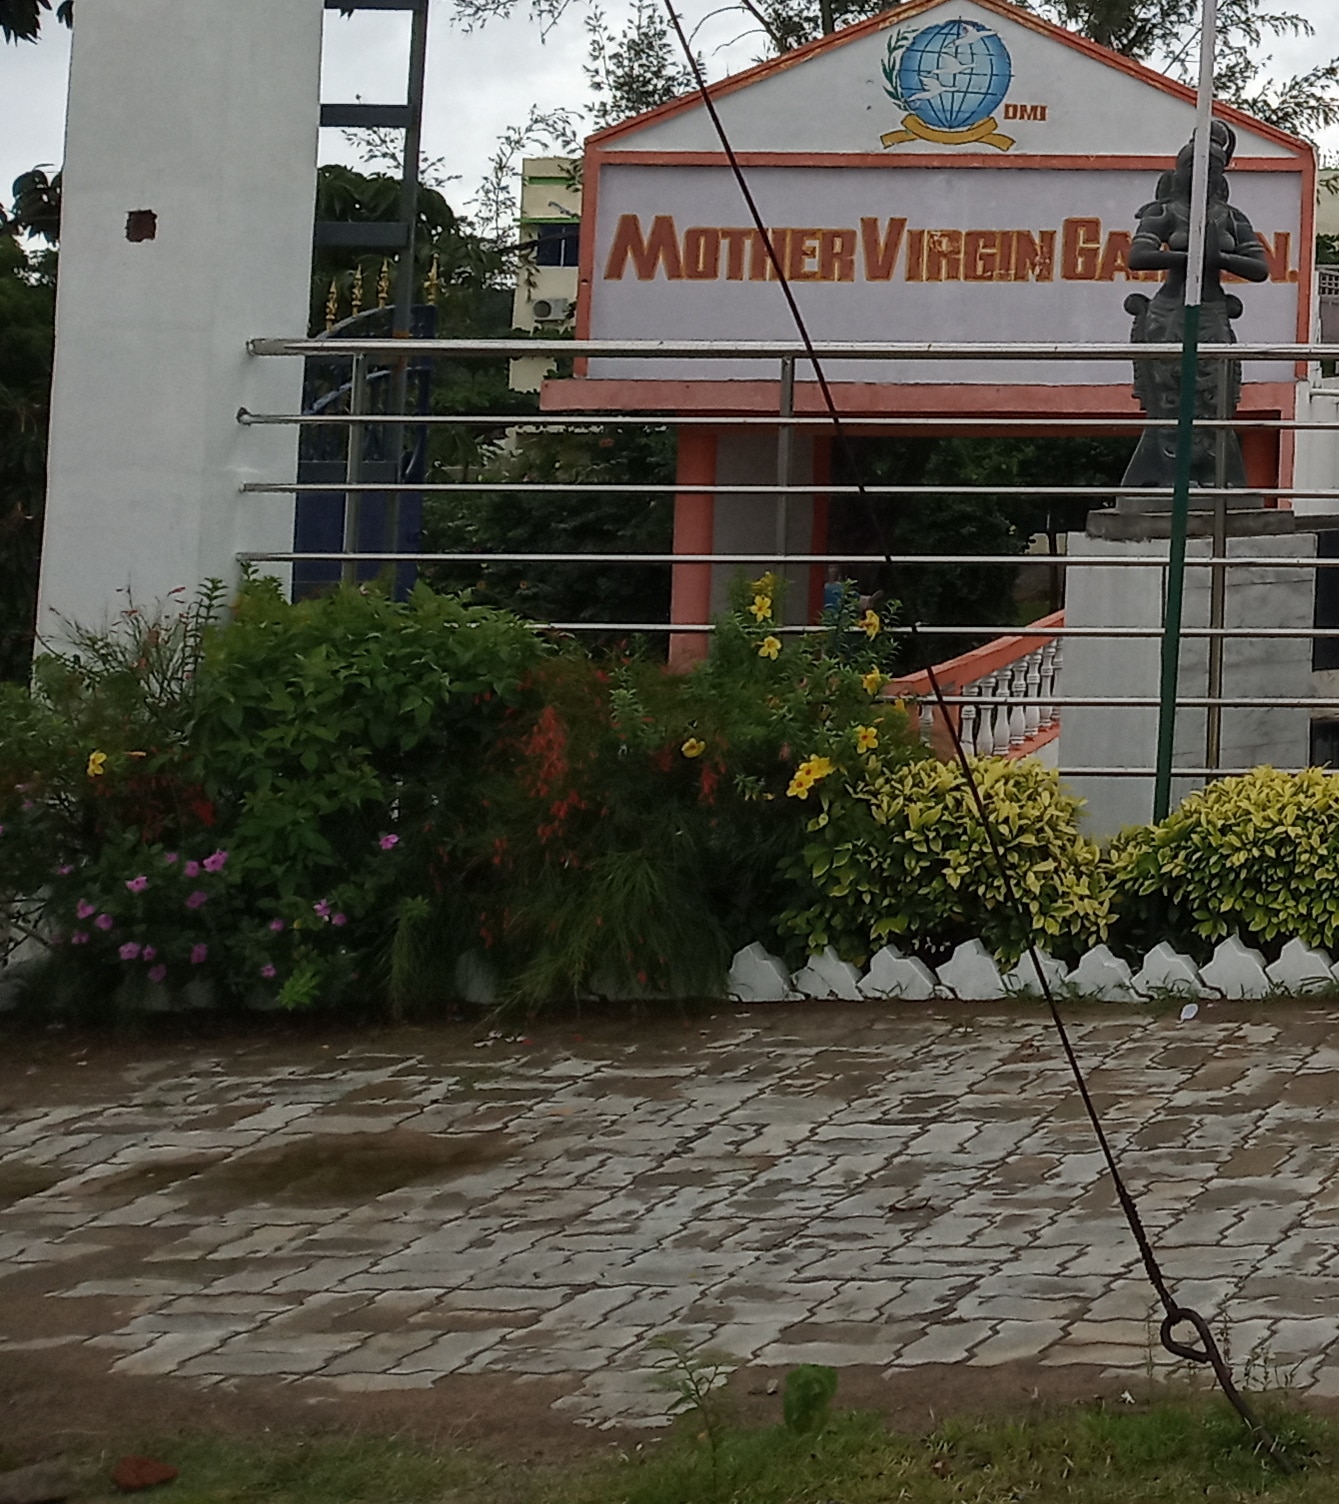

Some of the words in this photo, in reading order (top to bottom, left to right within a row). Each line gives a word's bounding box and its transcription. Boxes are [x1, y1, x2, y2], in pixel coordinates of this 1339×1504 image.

[1003, 103, 1047, 121] DMI
[604, 213, 858, 282] MOTHER
[860, 217, 1058, 283] VIRGIN
